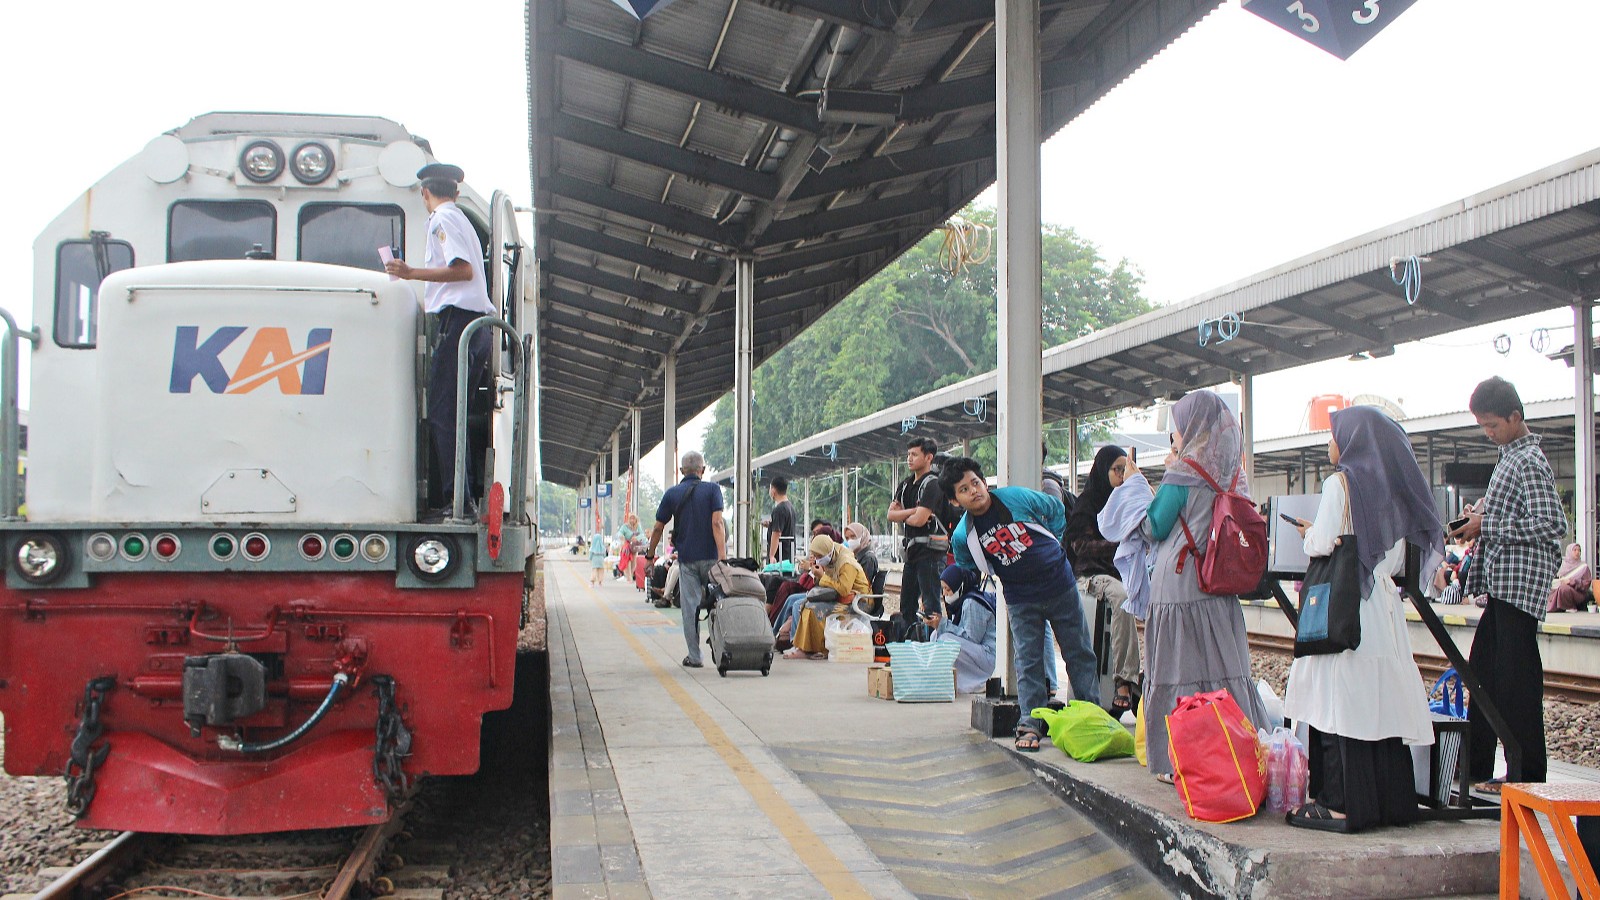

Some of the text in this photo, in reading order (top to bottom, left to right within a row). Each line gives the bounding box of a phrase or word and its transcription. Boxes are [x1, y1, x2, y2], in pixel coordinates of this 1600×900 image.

[1286, 1, 1320, 33] 3
[1352, 0, 1380, 25] 3
[169, 326, 332, 395] KAI
